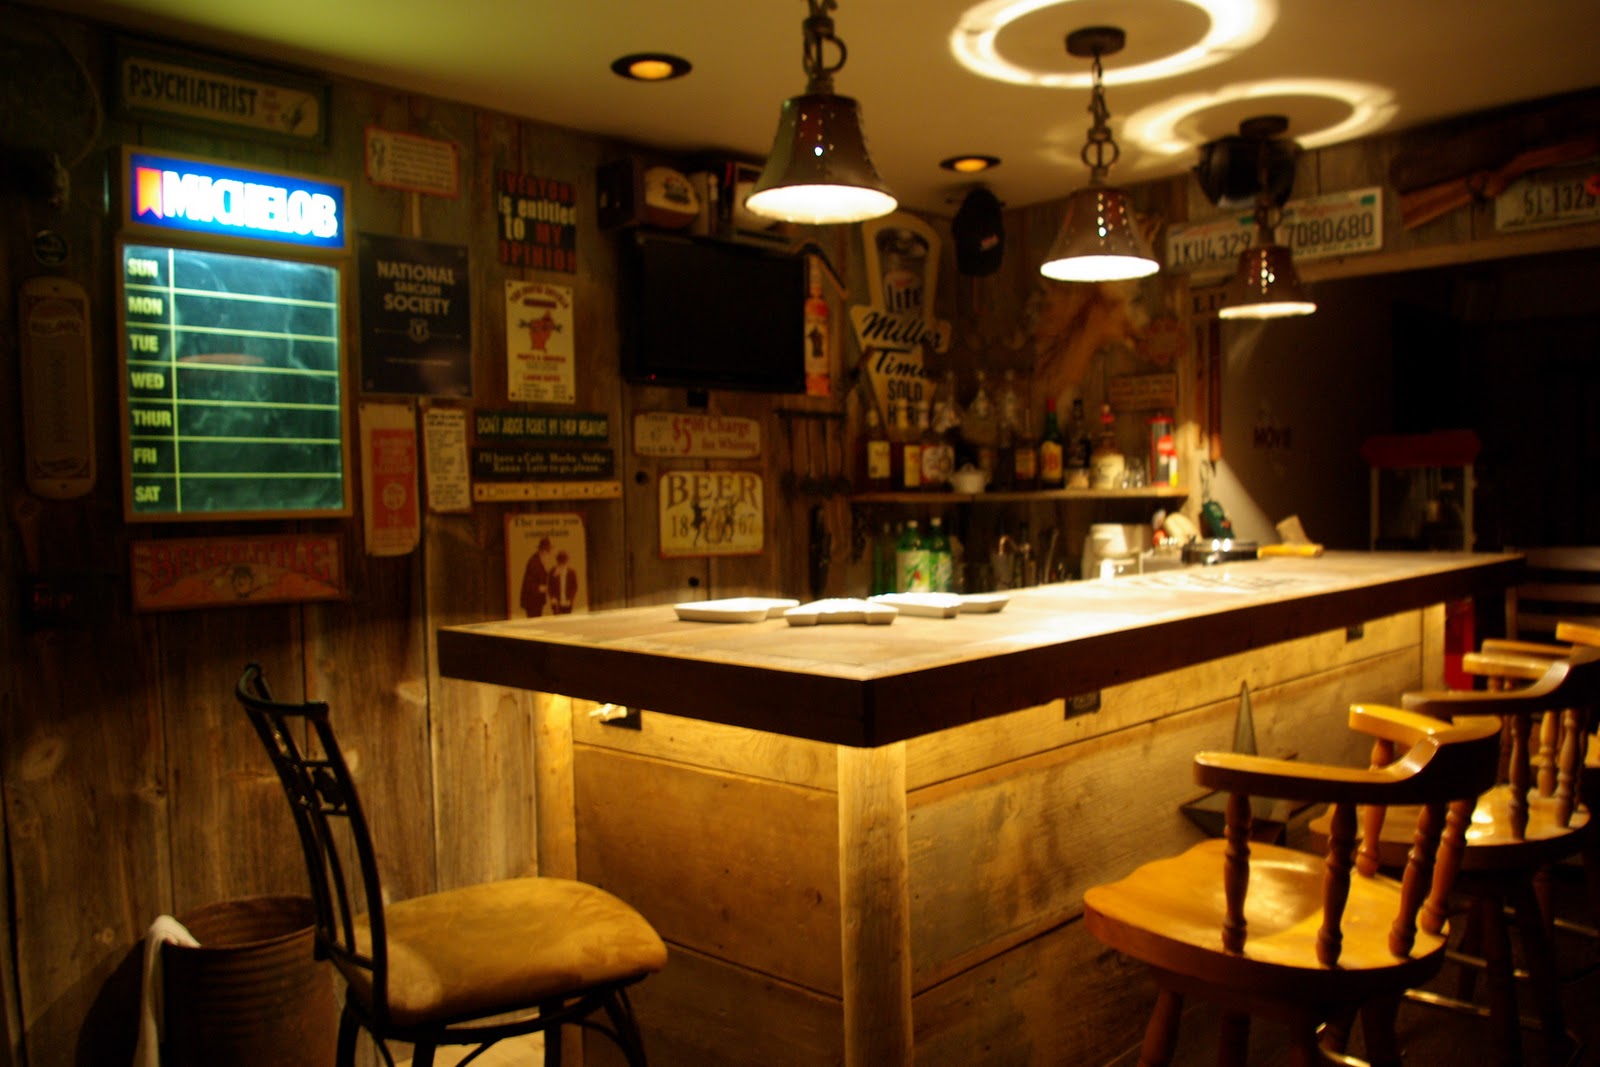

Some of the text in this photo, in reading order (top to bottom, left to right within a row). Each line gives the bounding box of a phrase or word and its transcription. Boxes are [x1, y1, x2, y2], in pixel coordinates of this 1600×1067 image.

[128, 64, 258, 117] PSYCHIATRIST
[162, 169, 339, 239] MICHELOB
[517, 196, 577, 226] entitled
[504, 214, 562, 245] to MY
[127, 258, 159, 278] SUN
[499, 239, 577, 275] OPINION
[376, 259, 457, 287] NATIONAL
[127, 297, 164, 316] MON
[383, 292, 452, 317] SOCIETY
[861, 311, 942, 349] Miller
[129, 335, 160, 354] TUE
[131, 372, 165, 390] WED
[887, 379, 924, 403] SOLD
[132, 410, 172, 428] THUR
[133, 447, 158, 465] FRI
[135, 486, 162, 503] SAT
[665, 474, 760, 513] BEER
[671, 514, 688, 538] 18
